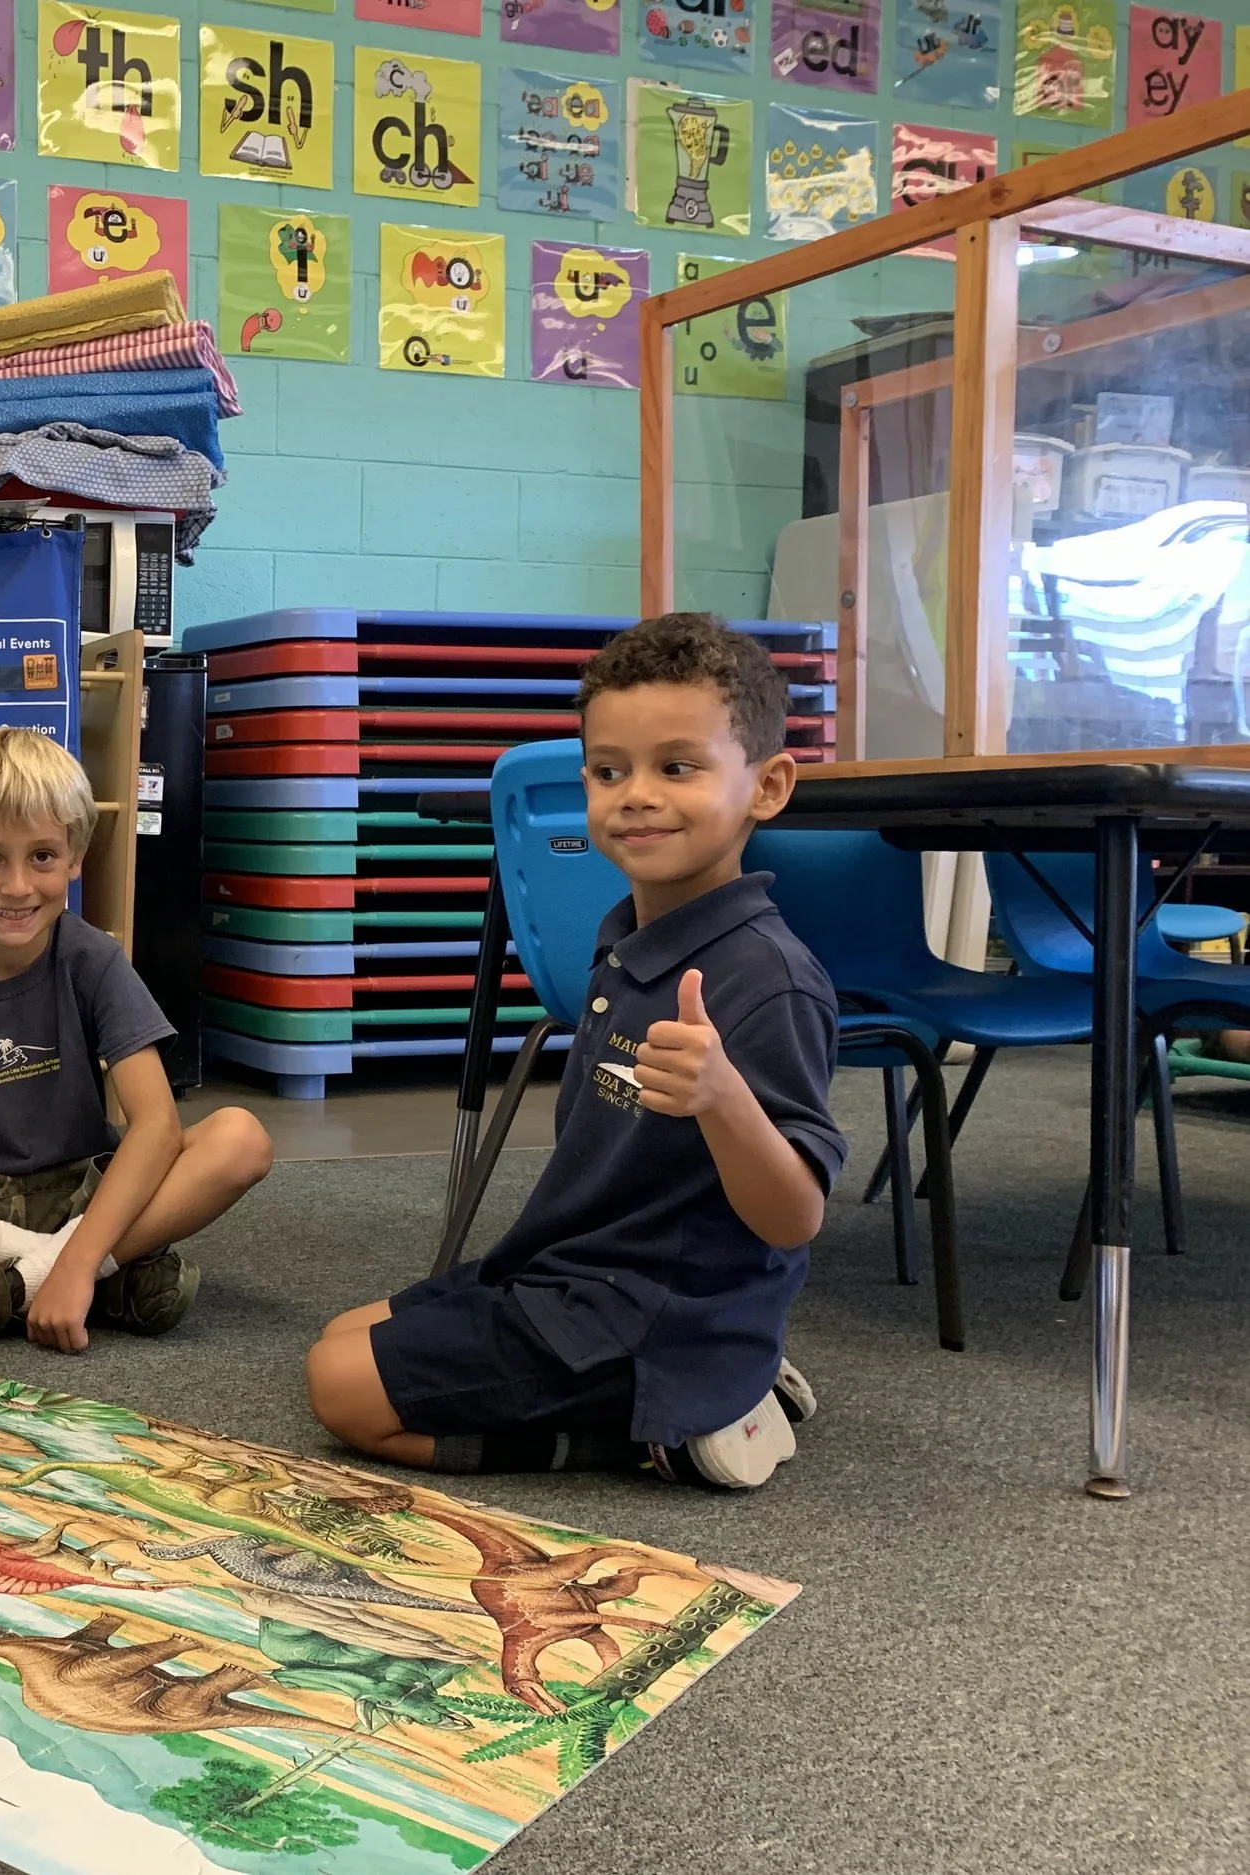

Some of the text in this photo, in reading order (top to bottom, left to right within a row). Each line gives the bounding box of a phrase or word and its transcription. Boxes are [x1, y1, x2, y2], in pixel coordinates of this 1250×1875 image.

[802, 25, 859, 76] ed
[1152, 16, 1205, 65] ay
[78, 27, 152, 117] th
[225, 40, 313, 128] sh
[1146, 70, 1189, 116] ey
[372, 102, 449, 173] ch
[684, 262, 699, 280] a
[700, 341, 717, 361] o
[684, 366, 698, 386] u
[10, 638, 51, 649] Events
[553, 840, 582, 848] LIFETIME
[609, 1032, 637, 1056] MAU
[593, 1068, 619, 1092] SDA
[597, 1087, 631, 1111] SINCE
